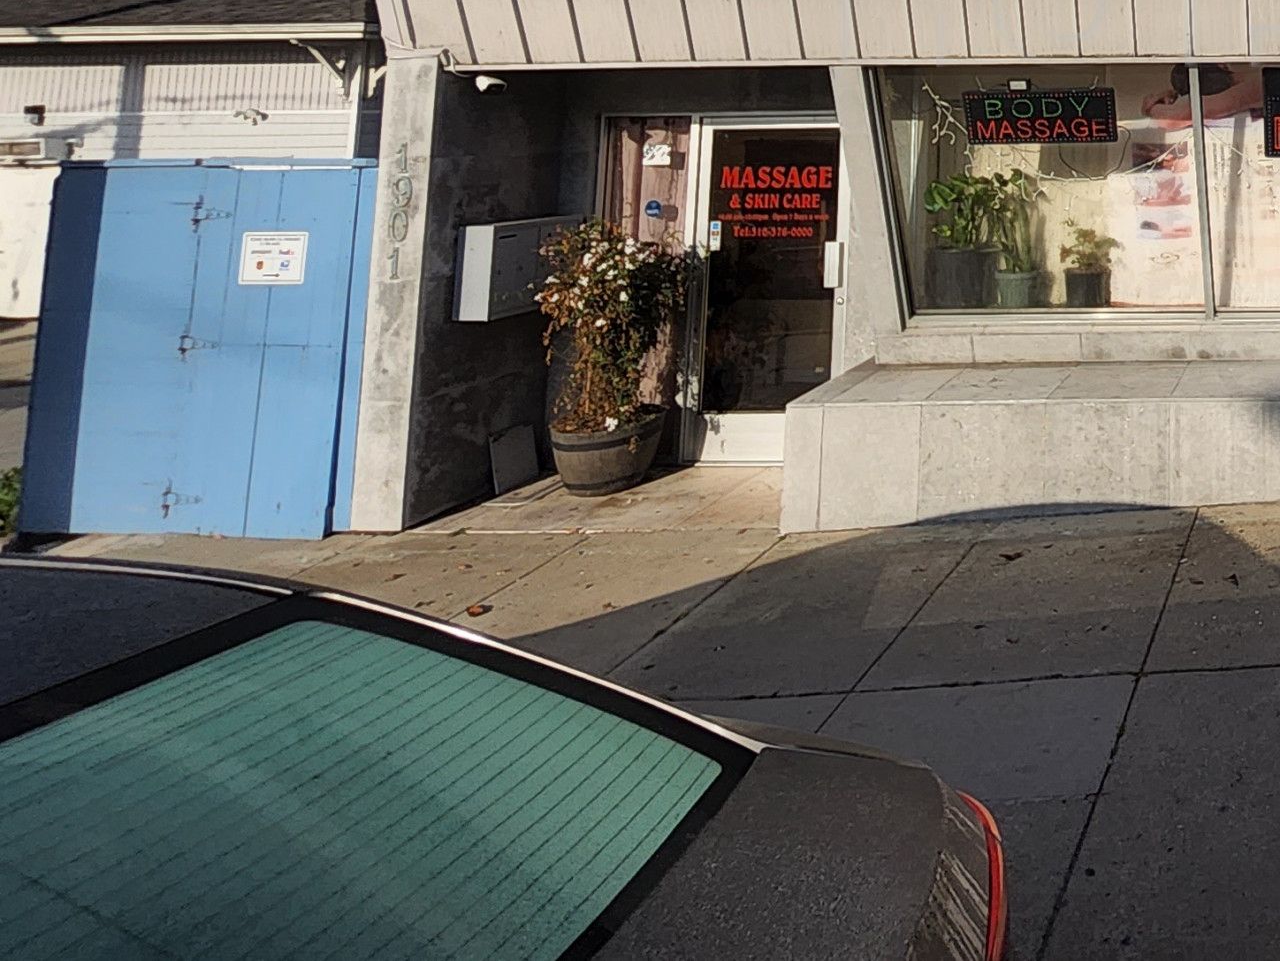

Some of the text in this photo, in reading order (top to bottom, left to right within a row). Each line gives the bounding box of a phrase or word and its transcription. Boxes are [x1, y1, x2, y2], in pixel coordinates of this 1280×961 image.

[984, 97, 1088, 119] BODY
[976, 118, 1107, 139] MASSAGE
[720, 165, 833, 189] MASSAGE
[387, 142, 412, 280] 1901
[729, 193, 821, 209] & SKIN CARE
